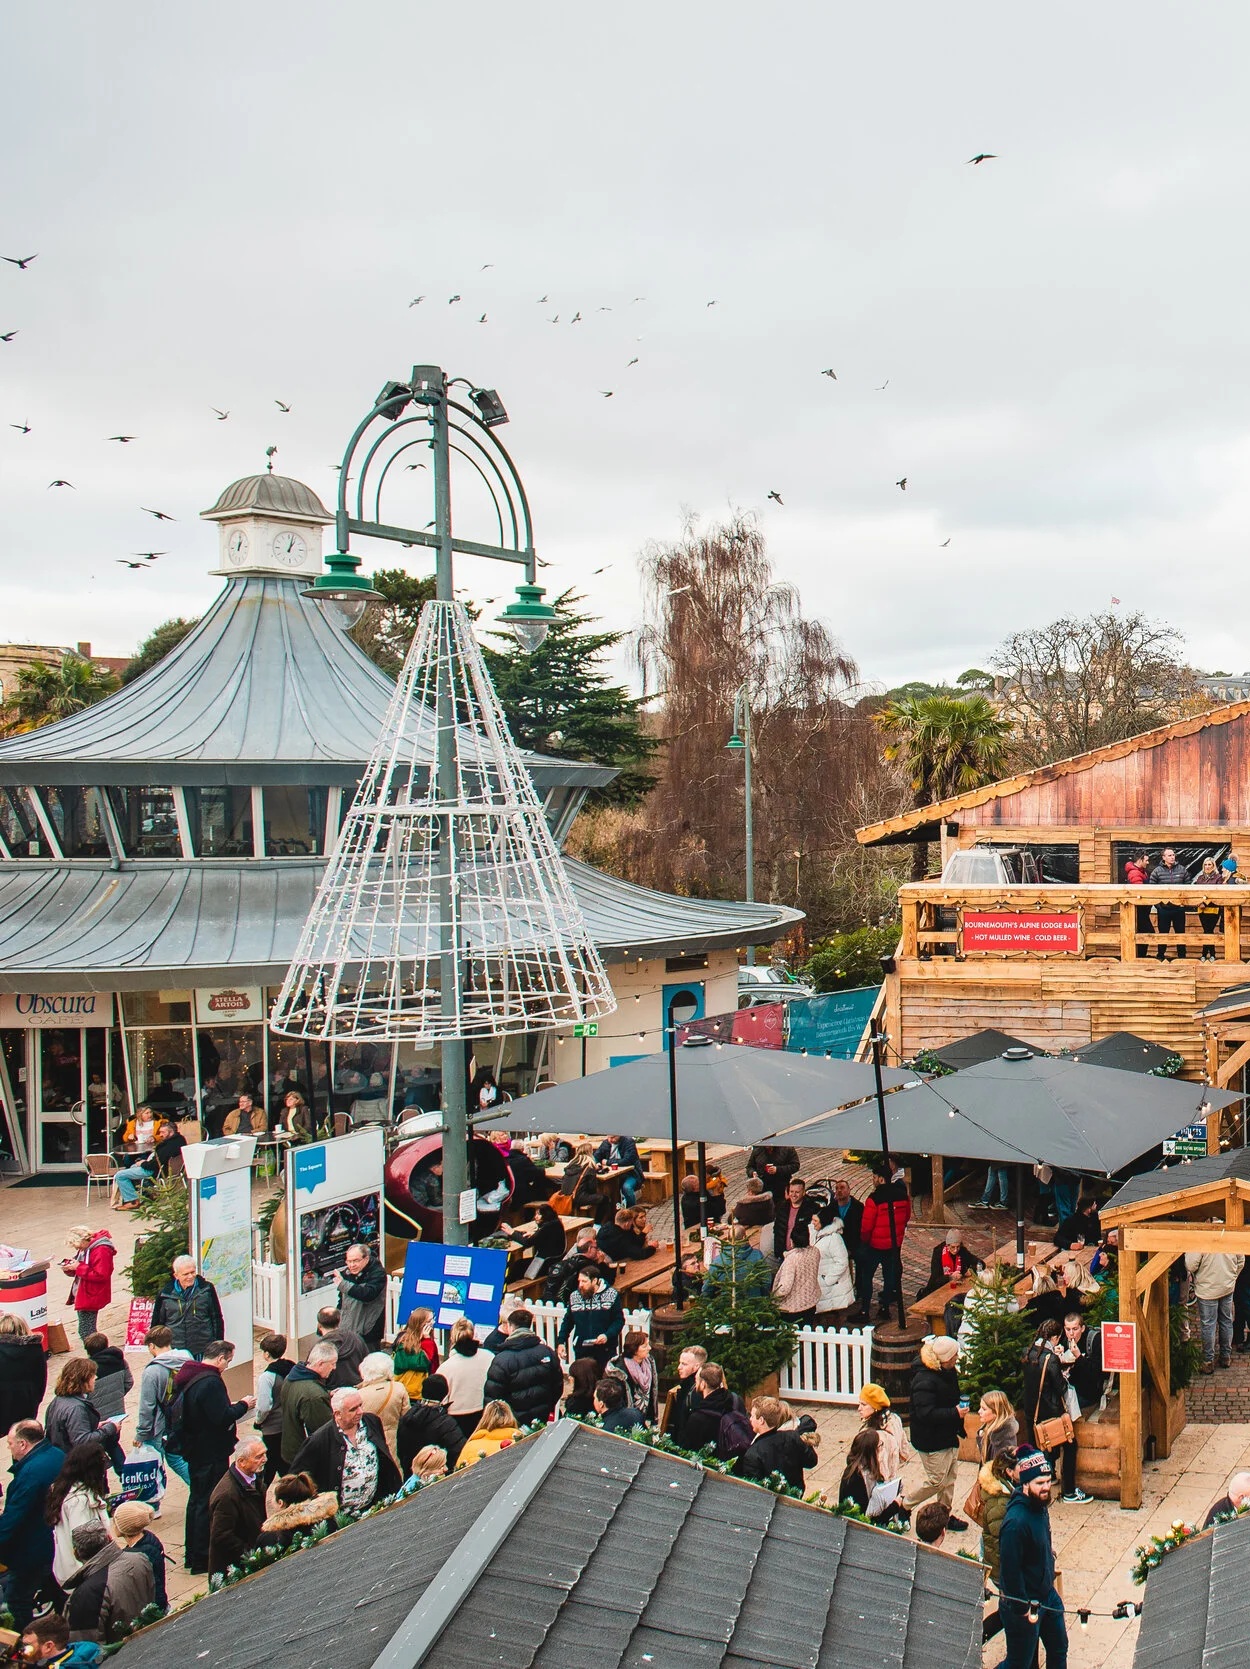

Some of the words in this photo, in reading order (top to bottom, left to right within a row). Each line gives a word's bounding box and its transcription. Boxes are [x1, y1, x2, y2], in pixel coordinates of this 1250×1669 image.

[964, 921, 1018, 929] BOURNEMOUTH'S
[1019, 921, 1040, 929] ALPINE
[1041, 921, 1063, 929] LODGE
[1034, 934, 1052, 942] COLD
[1053, 934, 1068, 942] BEER
[15, 993, 97, 1015] Obscura
